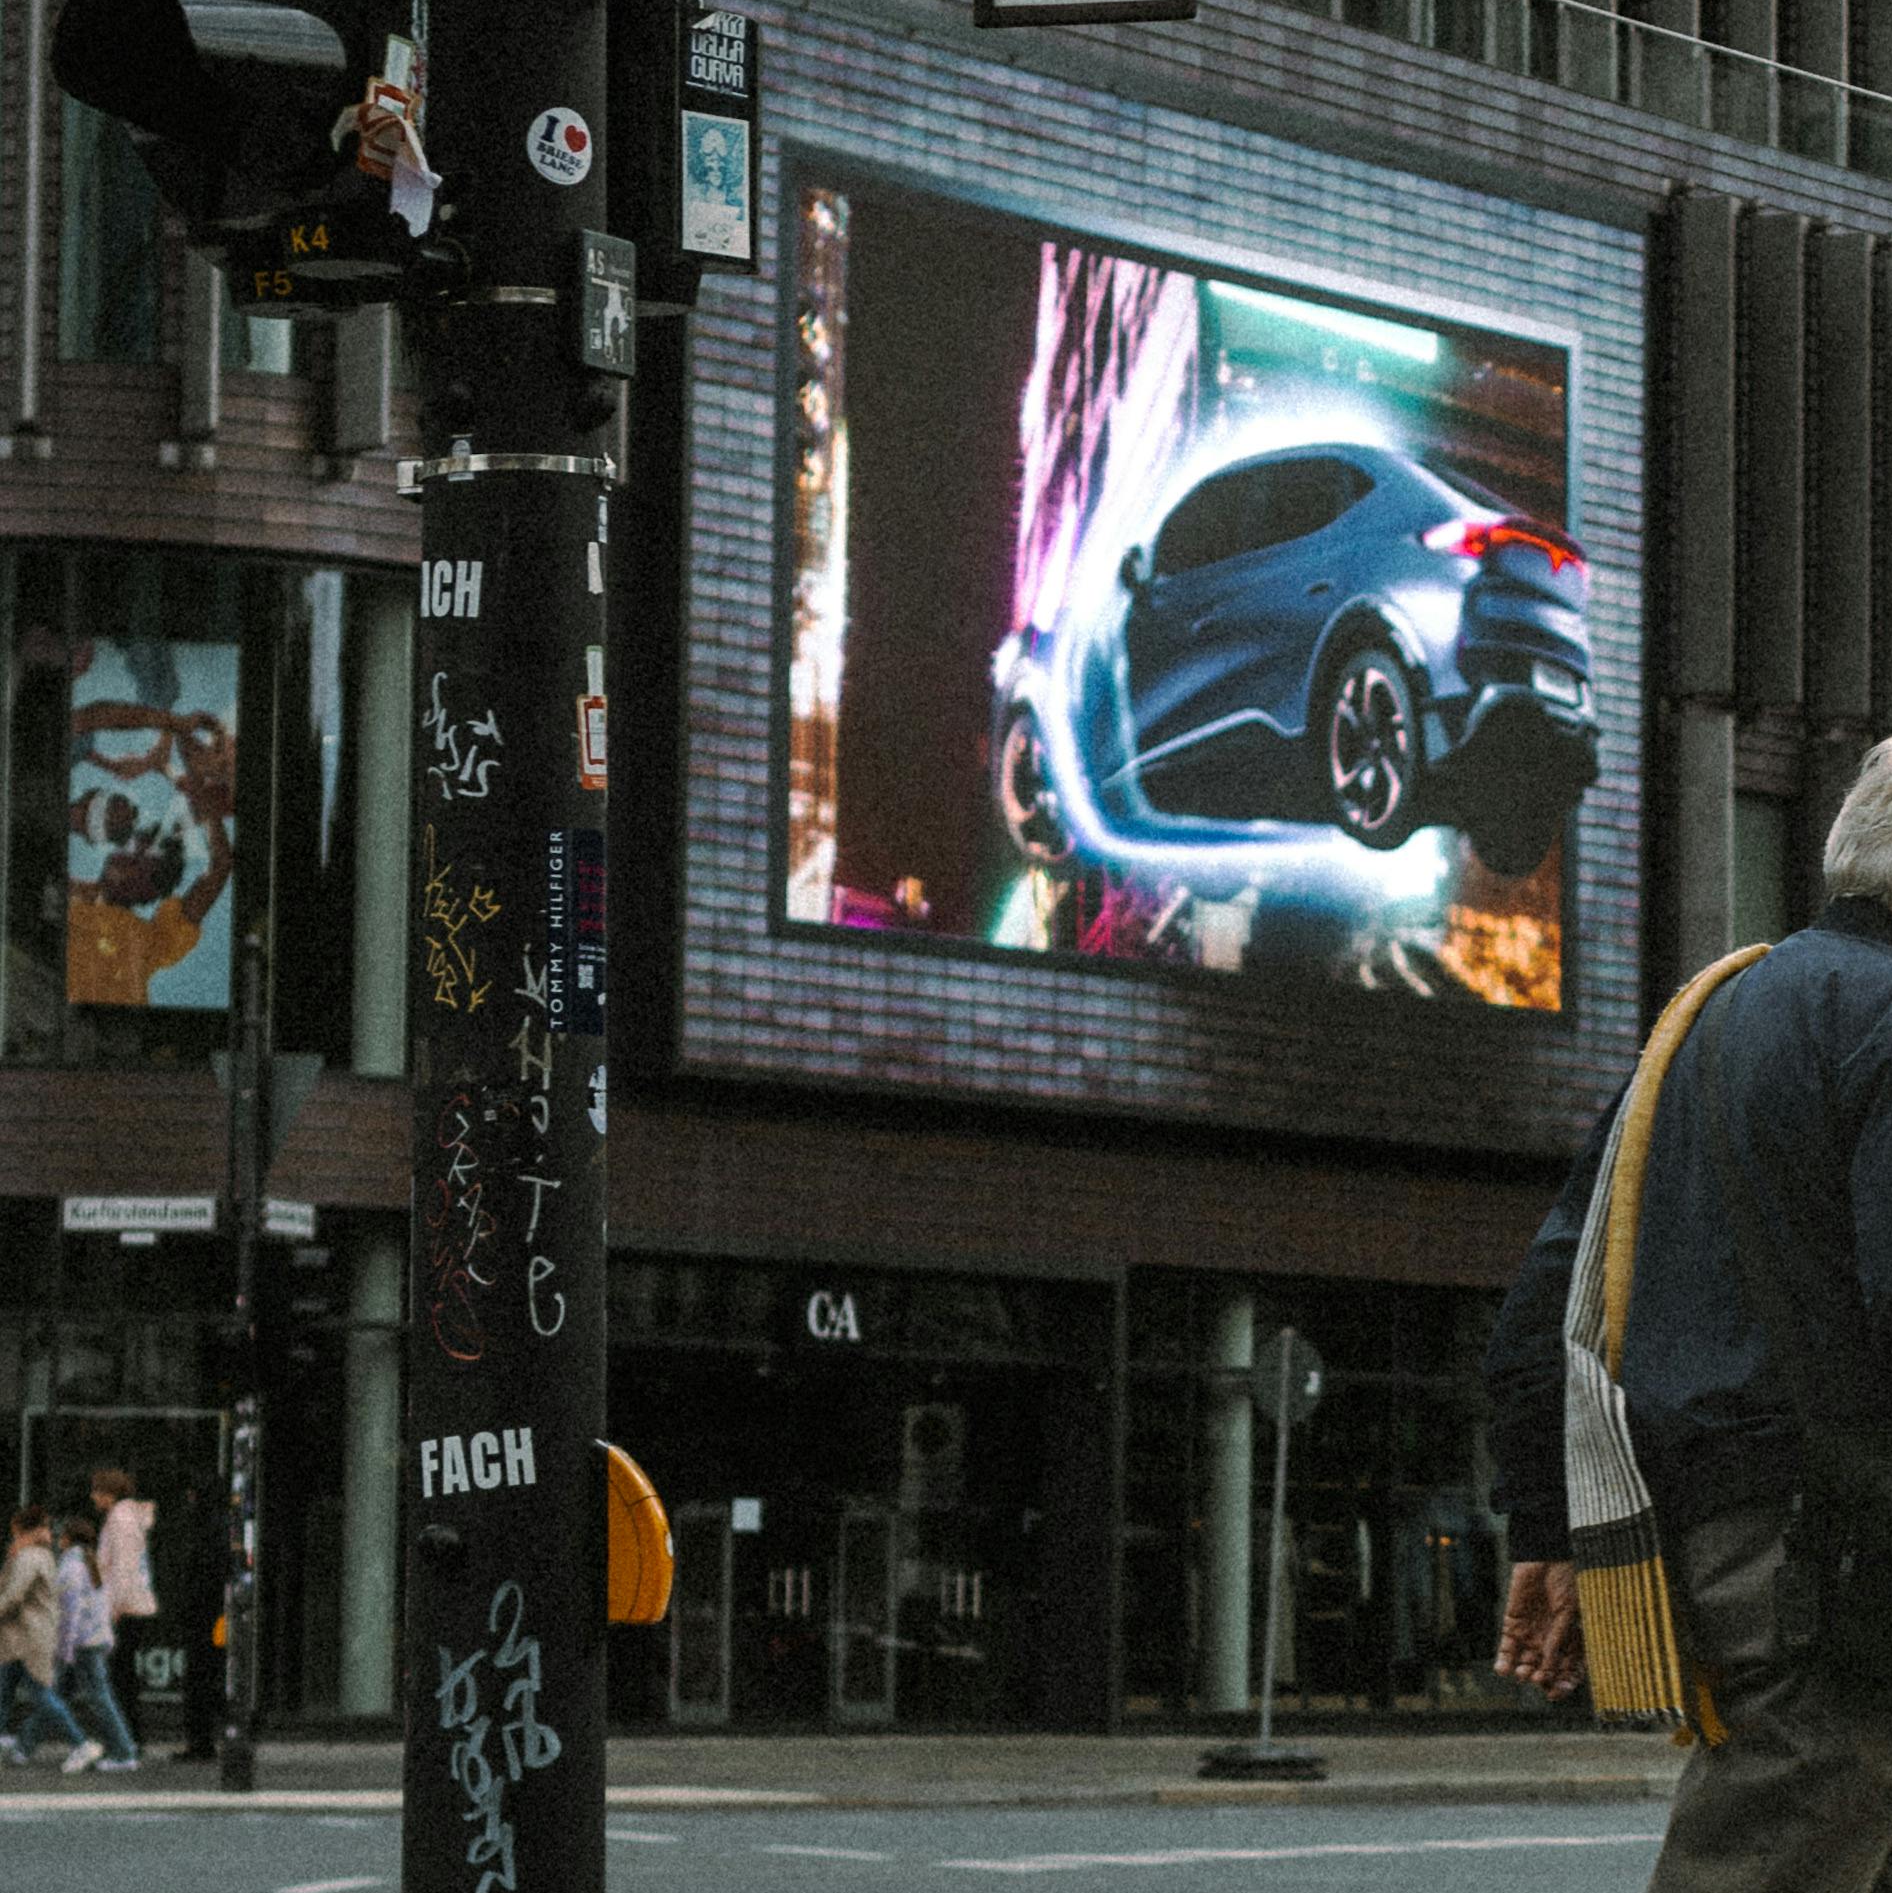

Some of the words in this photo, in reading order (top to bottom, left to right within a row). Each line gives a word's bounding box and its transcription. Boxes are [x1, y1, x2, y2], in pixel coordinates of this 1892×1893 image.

[691, 54, 744, 88] CURVA
[540, 114, 561, 143] I
[290, 224, 330, 253] K4
[254, 269, 294, 297] F5
[549, 831, 564, 928] HILFIGER
[549, 944, 564, 1029] TOMMY
[420, 1426, 537, 1499] FACH
